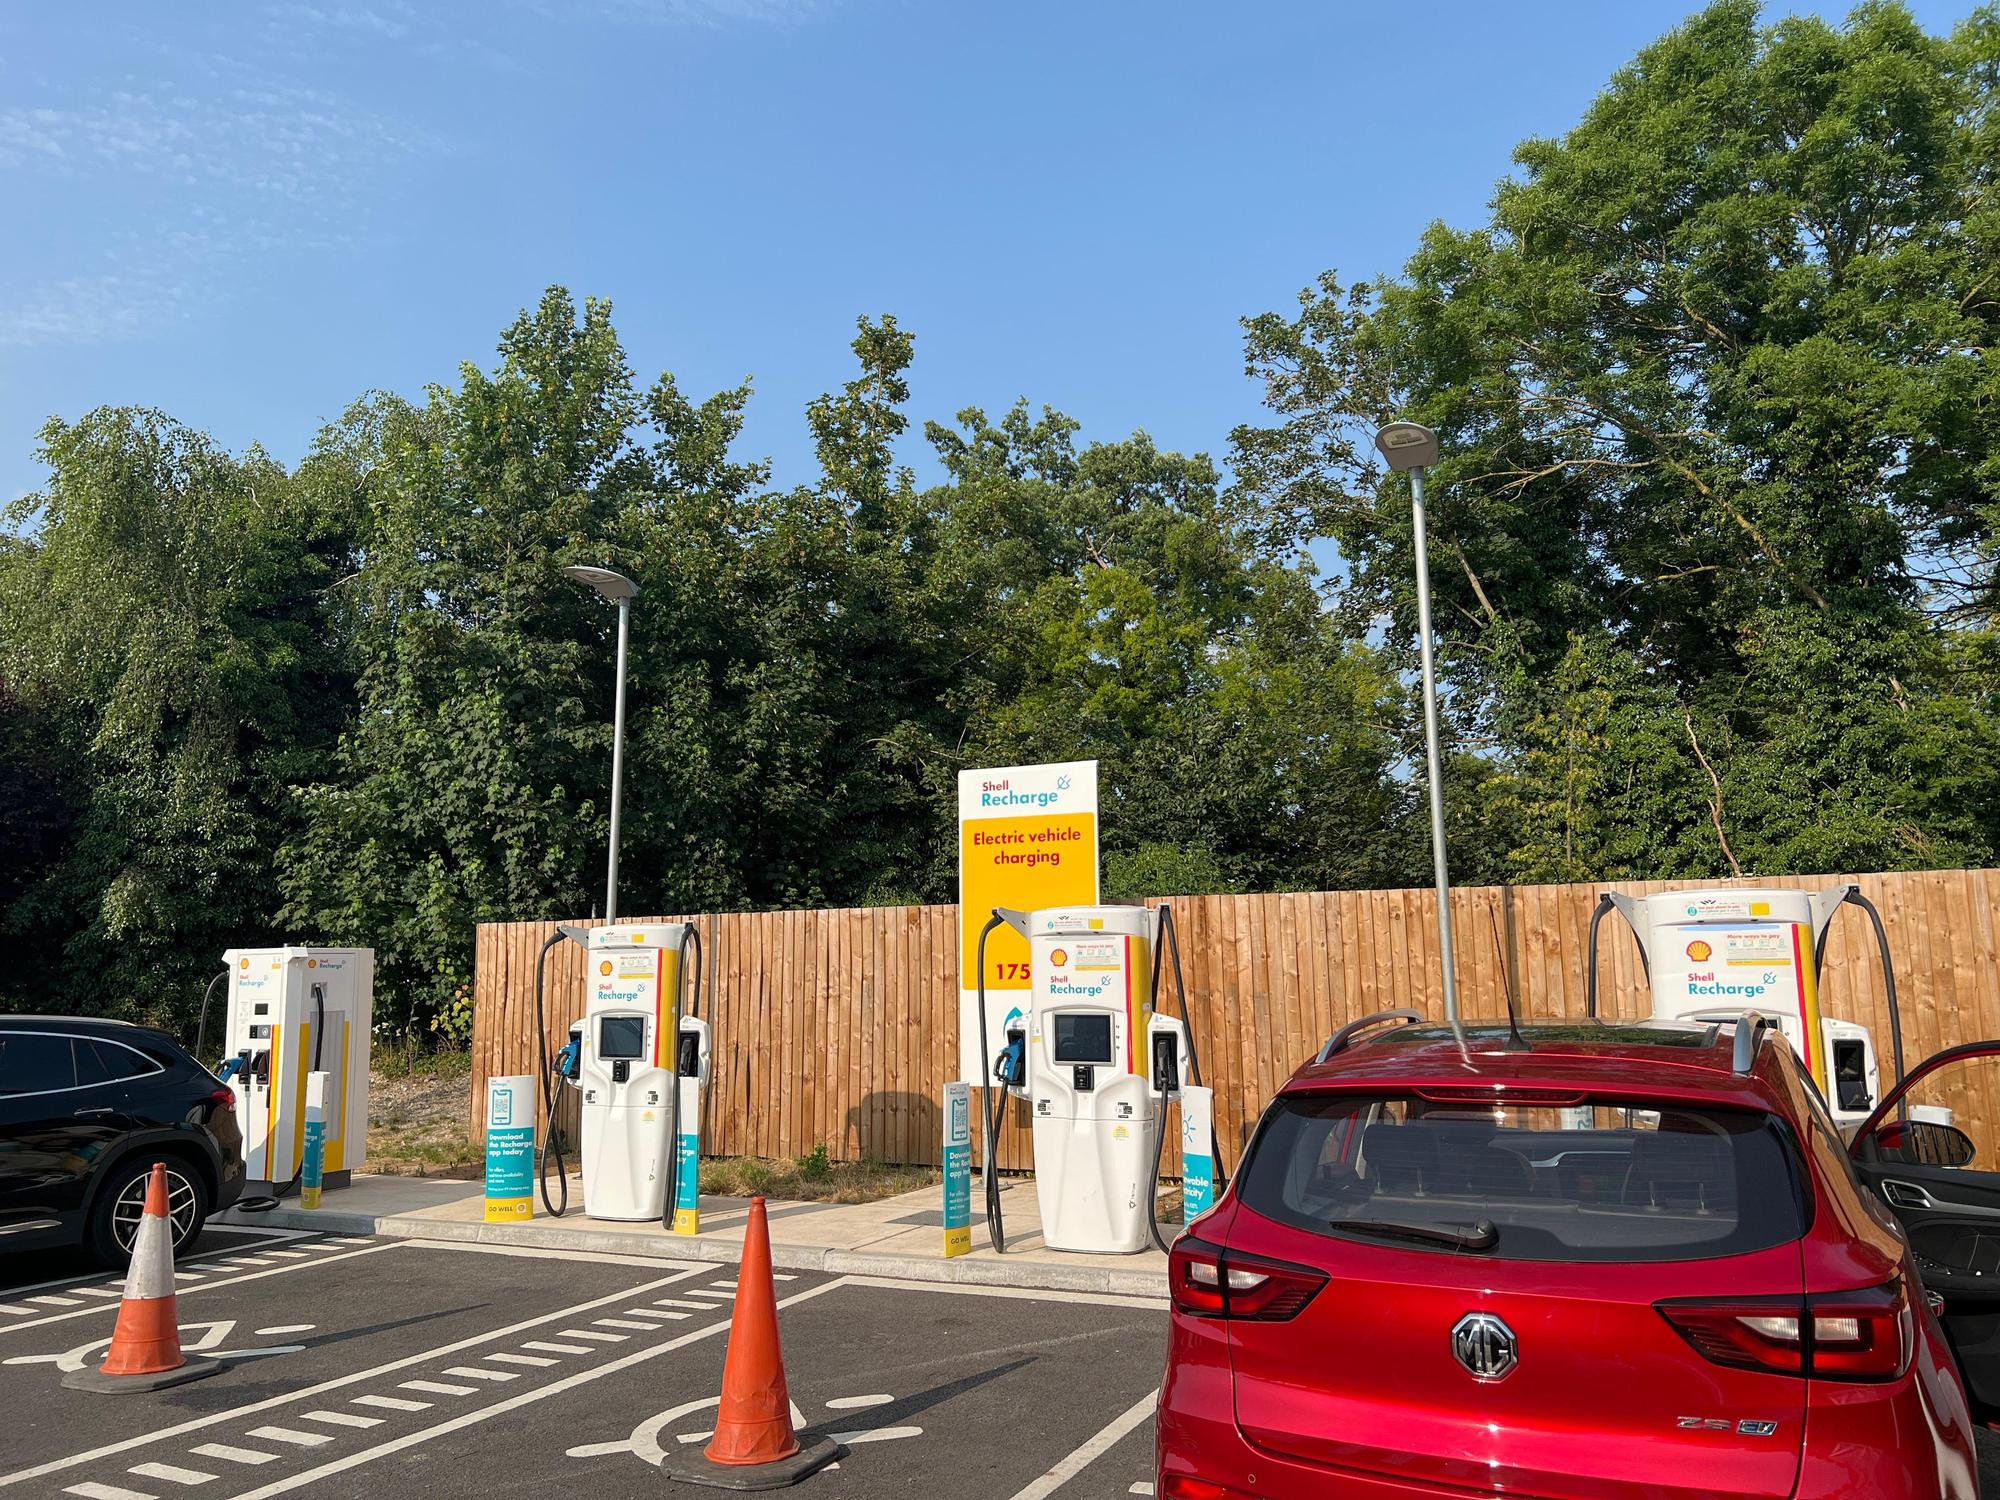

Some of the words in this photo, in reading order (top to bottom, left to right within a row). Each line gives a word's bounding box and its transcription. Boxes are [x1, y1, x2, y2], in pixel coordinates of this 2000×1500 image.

[981, 780, 1009, 792] Shell
[981, 790, 1058, 807] Recharge
[973, 831, 1025, 846] Electric
[1029, 827, 1081, 842] vehicle
[994, 849, 1060, 867] charging
[997, 963, 1030, 979] 175
[1050, 975, 1068, 983] Shell
[1688, 972, 1714, 982] Shell
[239, 980, 264, 988] Recharge
[598, 990, 638, 1001] Recharge
[1050, 984, 1102, 997] Recharge
[1688, 982, 1765, 998] Recharge
[489, 1133, 524, 1141] Download
[501, 1140, 532, 1148] Recharge
[503, 1148, 524, 1157] today
[949, 1160, 960, 1168] the
[949, 1170, 962, 1180] app
[1458, 1322, 1509, 1375] MG
[1677, 1416, 1731, 1430] ZS
[1740, 1421, 1774, 1434] EV
